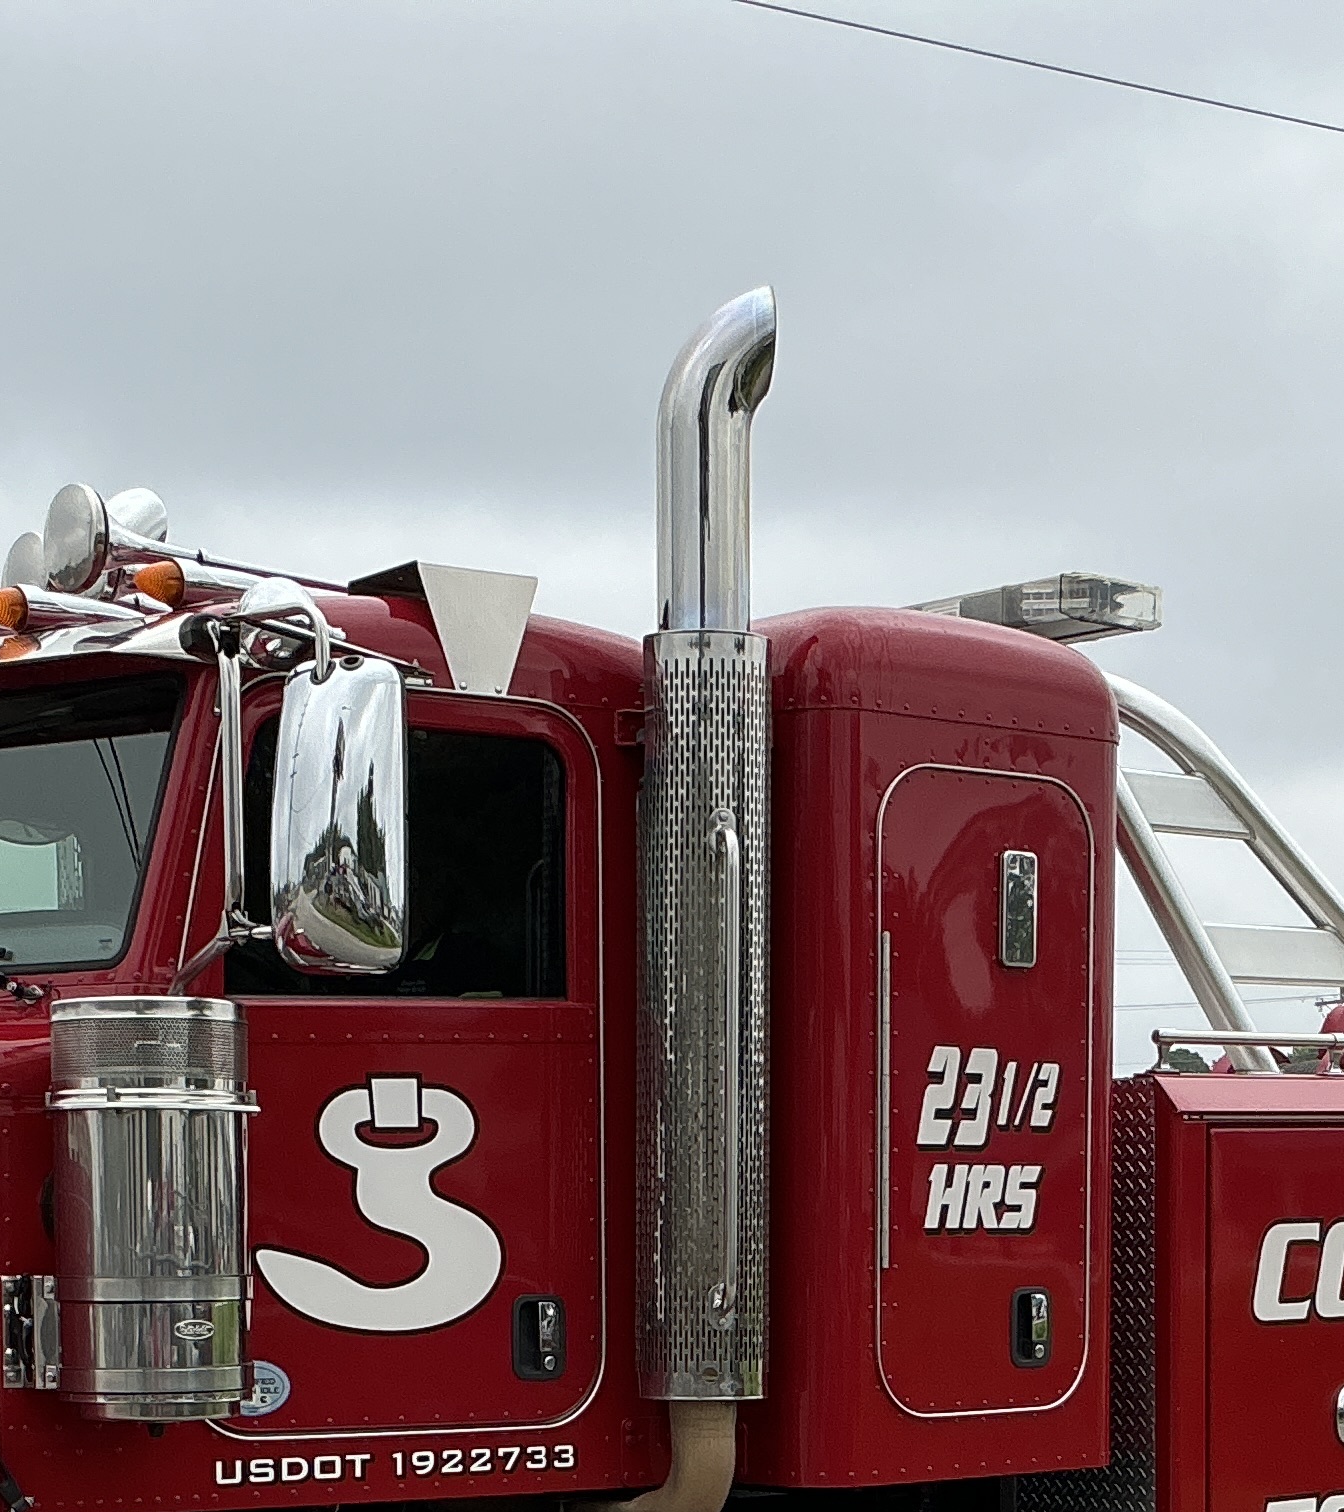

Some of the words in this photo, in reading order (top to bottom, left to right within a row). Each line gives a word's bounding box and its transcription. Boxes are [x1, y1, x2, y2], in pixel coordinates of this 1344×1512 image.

[923, 1163, 1043, 1230] HRS
[215, 1453, 372, 1485] USDOT
[391, 1444, 575, 1476] 1922733
